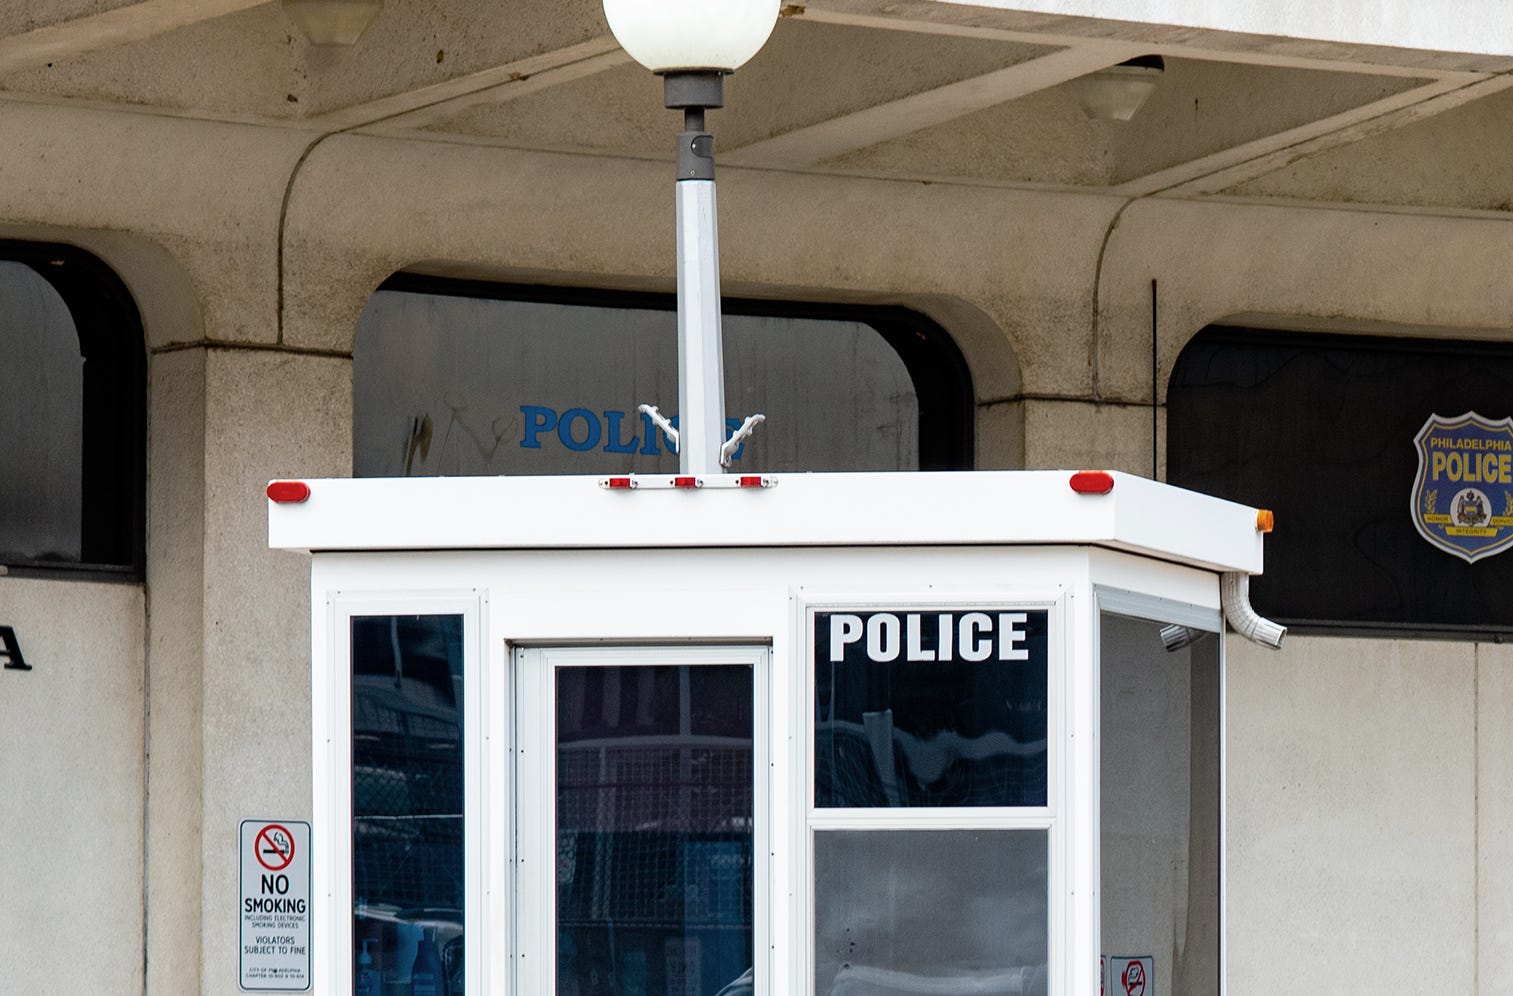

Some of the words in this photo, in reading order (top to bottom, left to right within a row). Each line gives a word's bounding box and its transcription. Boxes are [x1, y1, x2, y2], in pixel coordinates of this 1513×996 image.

[520, 405, 745, 460] POLI
[1430, 437, 1512, 451] PHILADELPHIA
[1432, 451, 1512, 484] POLICE
[830, 612, 1029, 662] POLICE
[261, 874, 290, 895] NO
[244, 898, 306, 913] SMOKING
[255, 936, 295, 945] VIOLATORS
[244, 946, 275, 954] SUBJECT
[278, 946, 288, 954] TO
[290, 947, 306, 955] FINE
